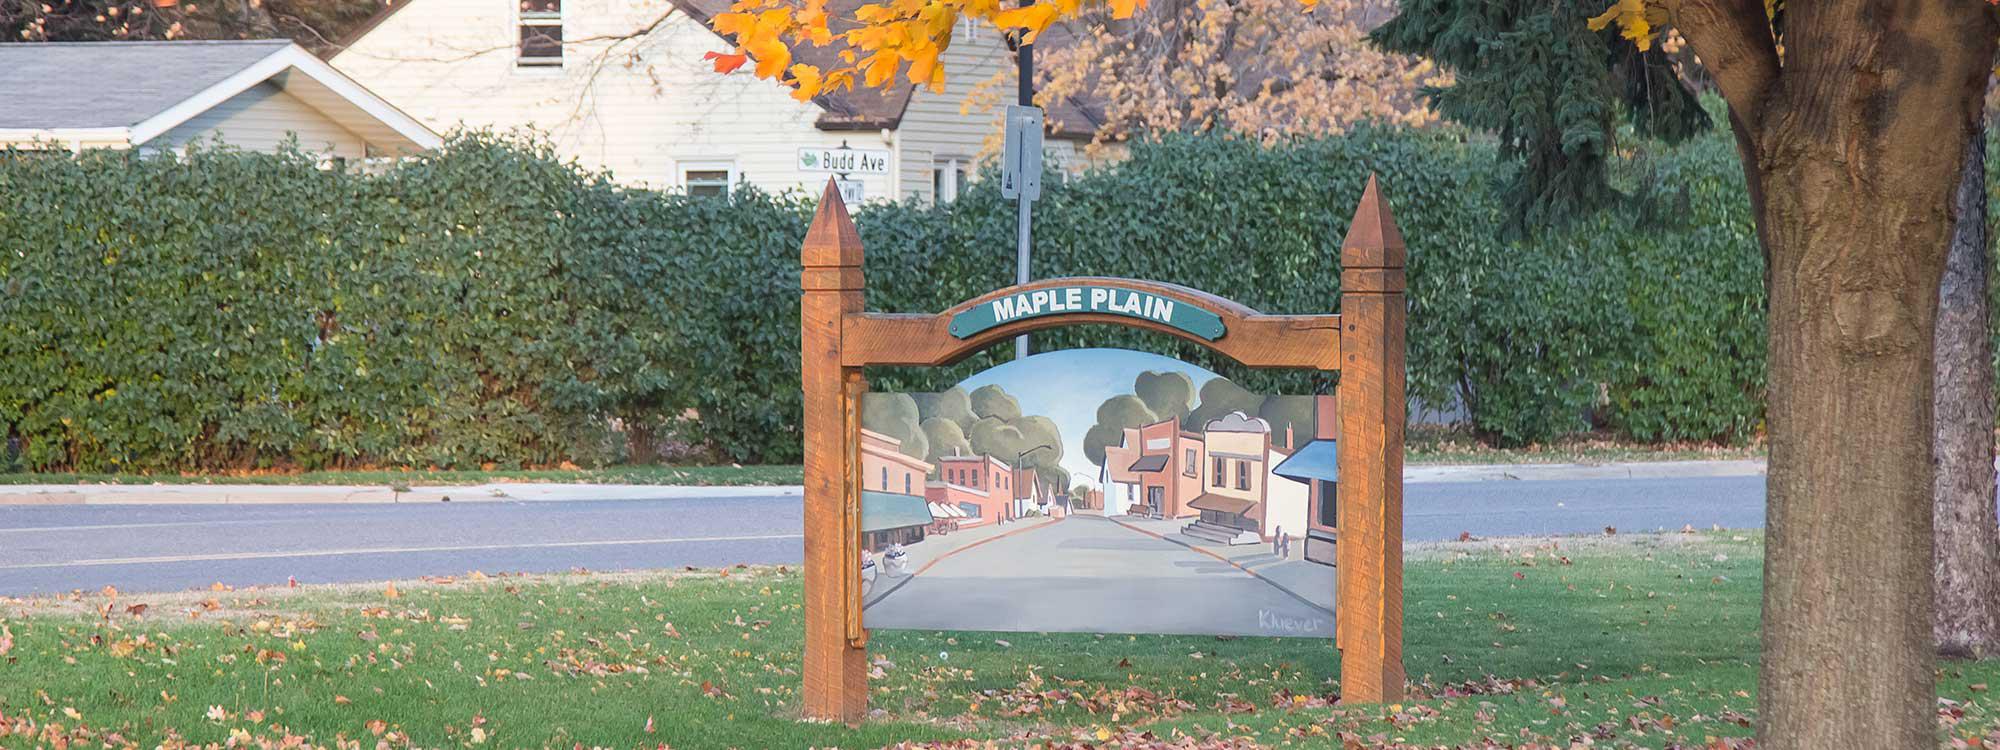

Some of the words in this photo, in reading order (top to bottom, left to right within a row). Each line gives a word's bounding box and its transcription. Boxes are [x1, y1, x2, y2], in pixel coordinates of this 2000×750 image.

[823, 151, 854, 170] Budd
[861, 153, 884, 171] Ave
[992, 288, 1082, 322] MAPLE
[1090, 288, 1174, 322] PLAIN
